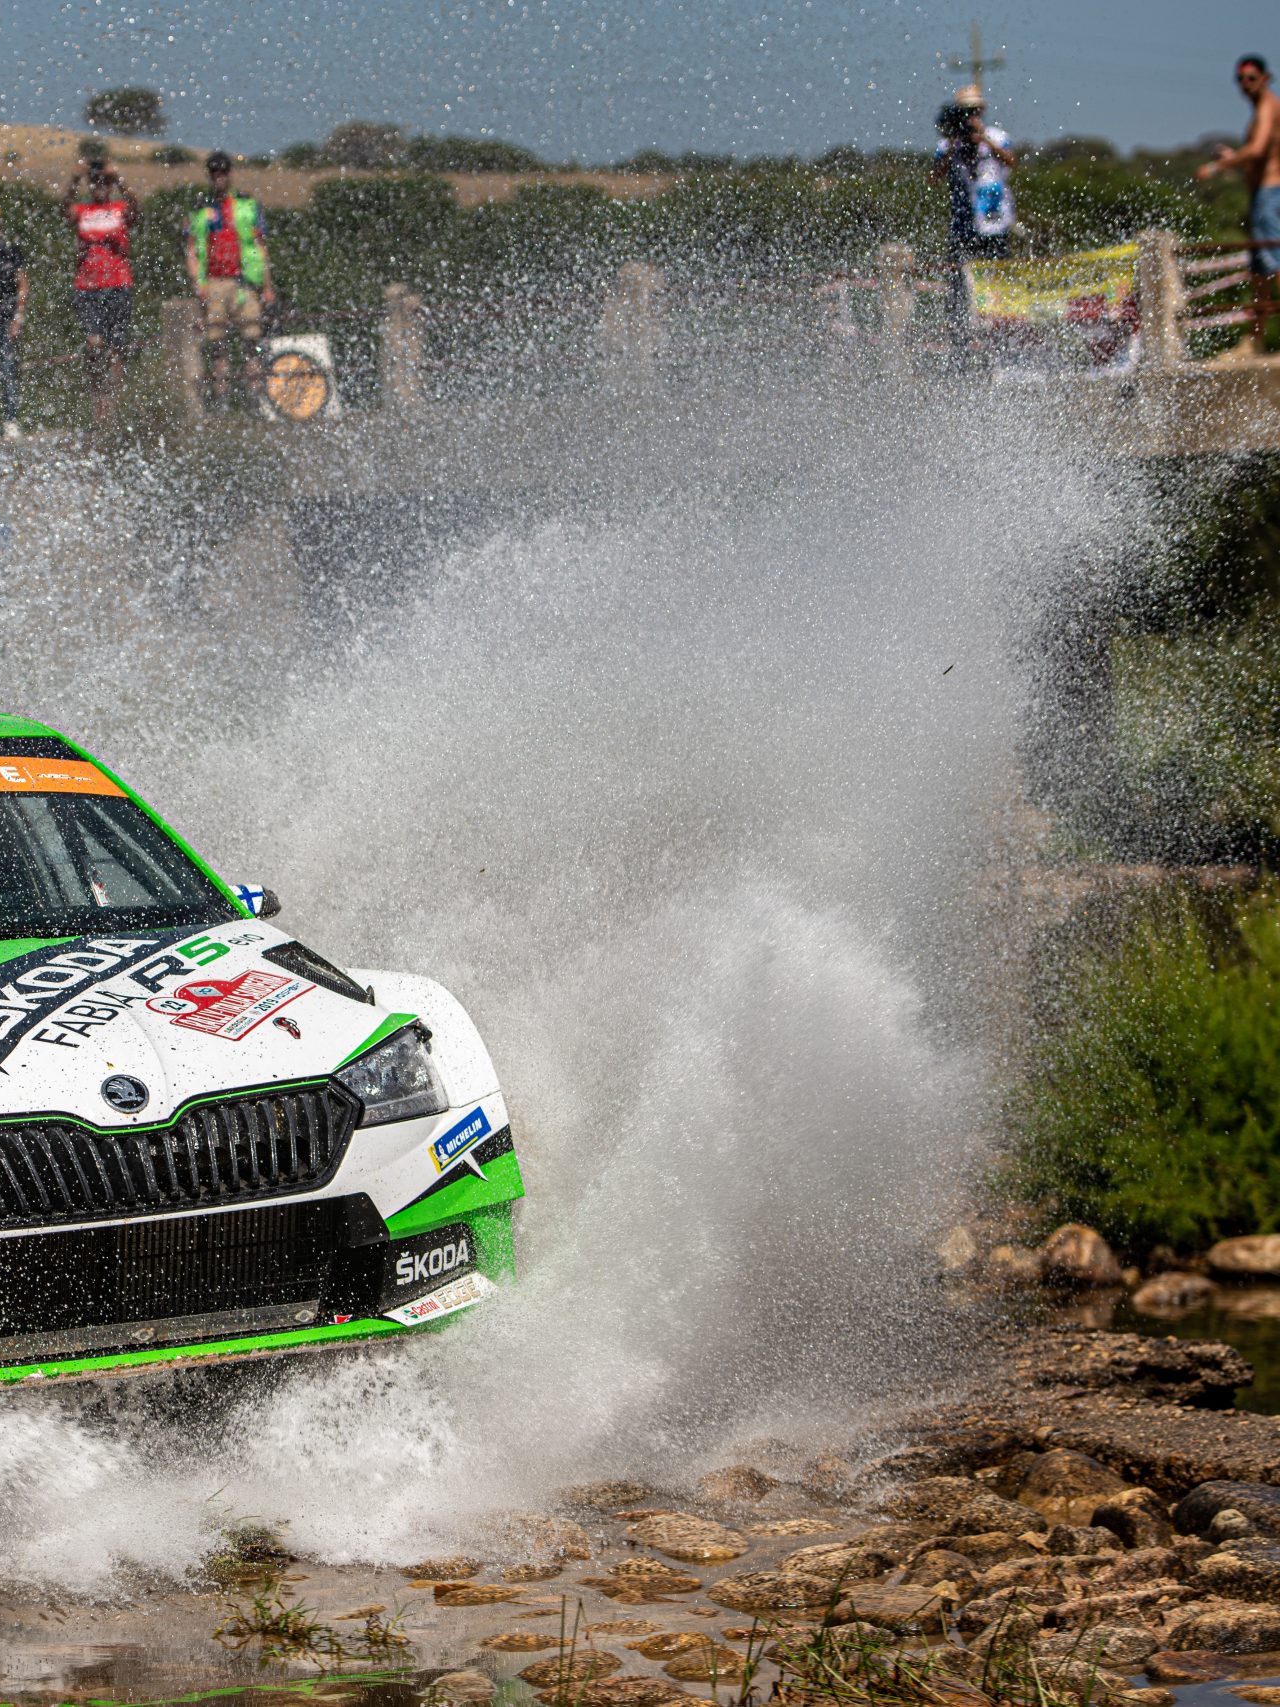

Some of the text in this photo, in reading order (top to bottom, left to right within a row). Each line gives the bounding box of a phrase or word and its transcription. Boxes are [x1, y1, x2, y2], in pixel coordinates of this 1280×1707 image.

[31, 933, 265, 1048] FABIA R5 evo
[160, 1000, 187, 1011] 22
[254, 998, 279, 1012] 2019
[446, 1118, 482, 1154] MICHELIN
[395, 1239, 470, 1286] ŠKODA
[411, 1299, 440, 1317] Castrol
